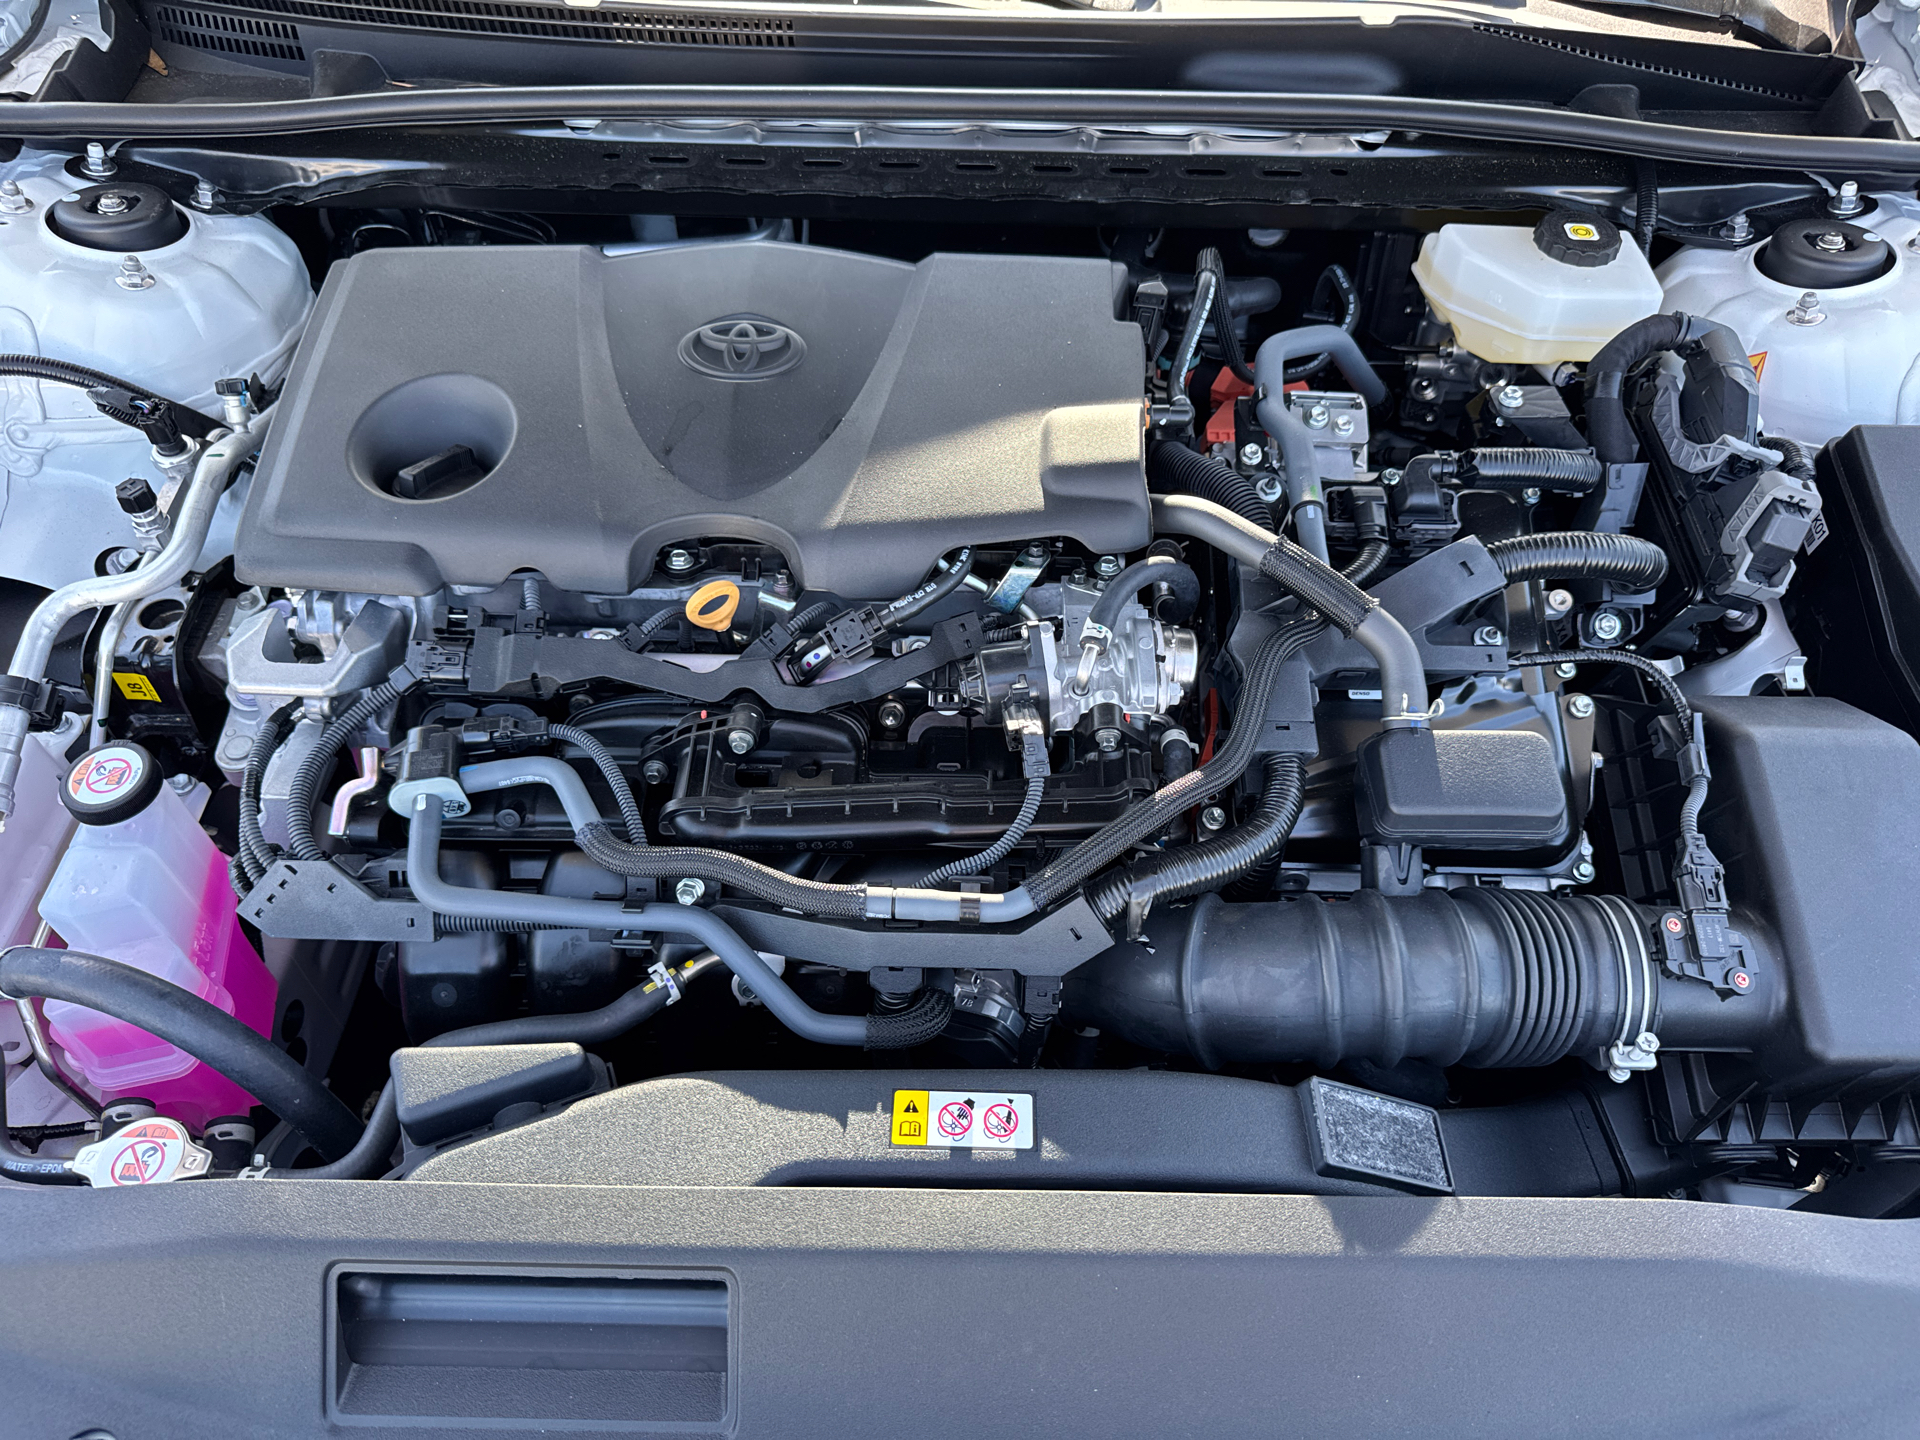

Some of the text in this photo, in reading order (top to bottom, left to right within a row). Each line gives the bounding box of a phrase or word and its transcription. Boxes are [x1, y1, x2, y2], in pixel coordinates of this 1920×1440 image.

[1811, 514, 1826, 540] K01
[127, 683, 147, 697] J8
[3, 1160, 34, 1173] WATER
